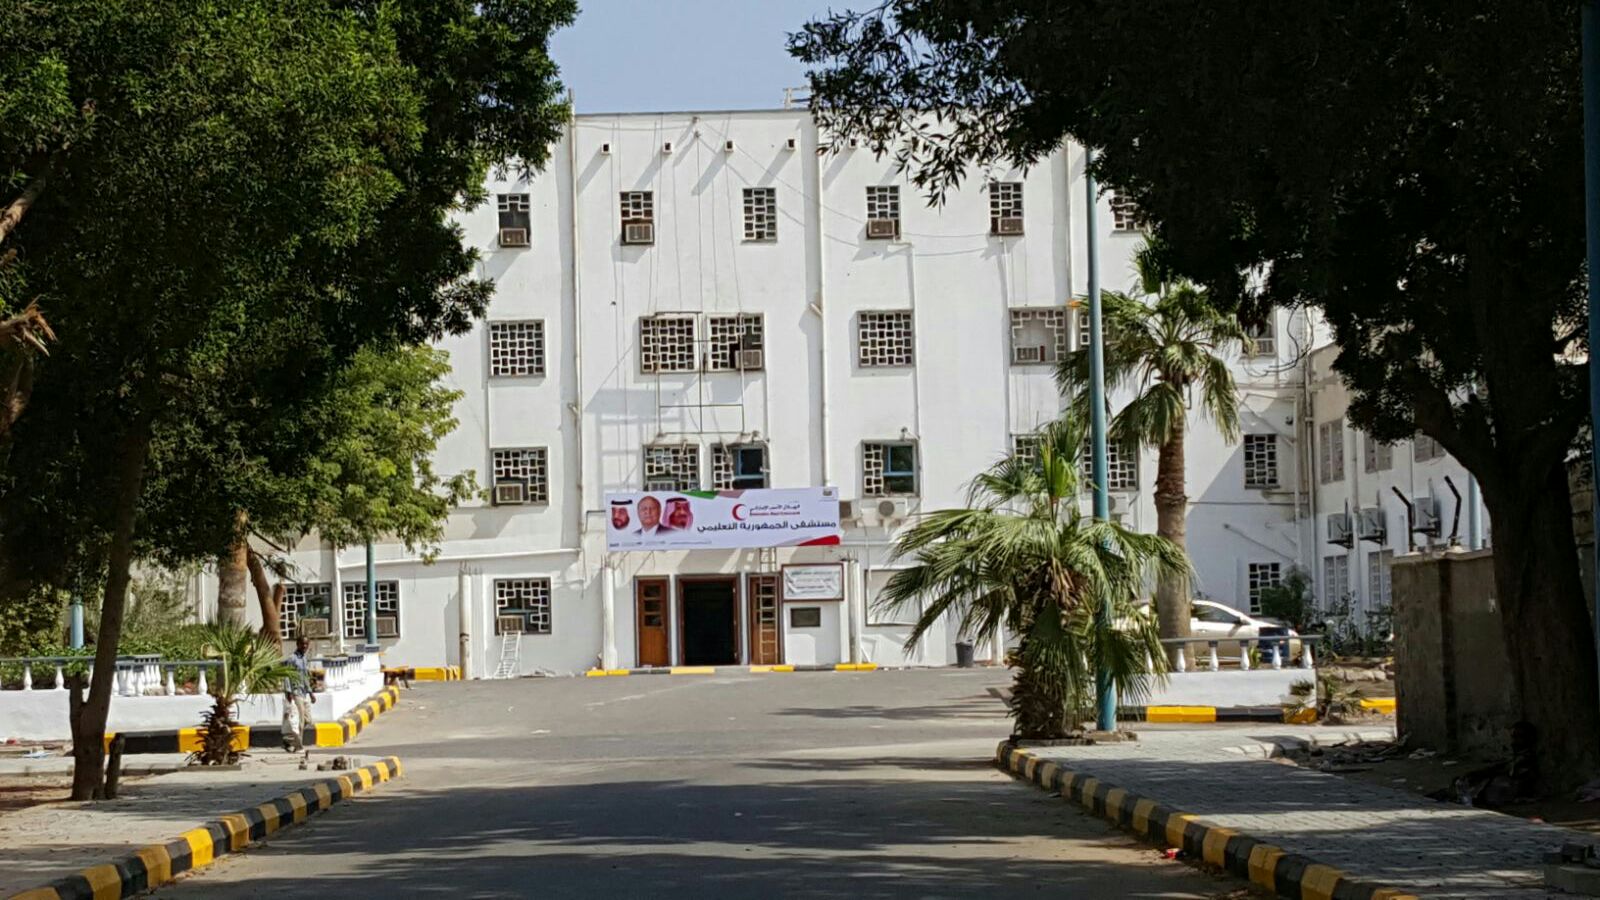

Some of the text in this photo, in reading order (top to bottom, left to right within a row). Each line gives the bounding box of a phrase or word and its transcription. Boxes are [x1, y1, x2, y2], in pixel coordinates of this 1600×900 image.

[697, 519, 837, 533] مستشفى الجمهورية التعليمي
